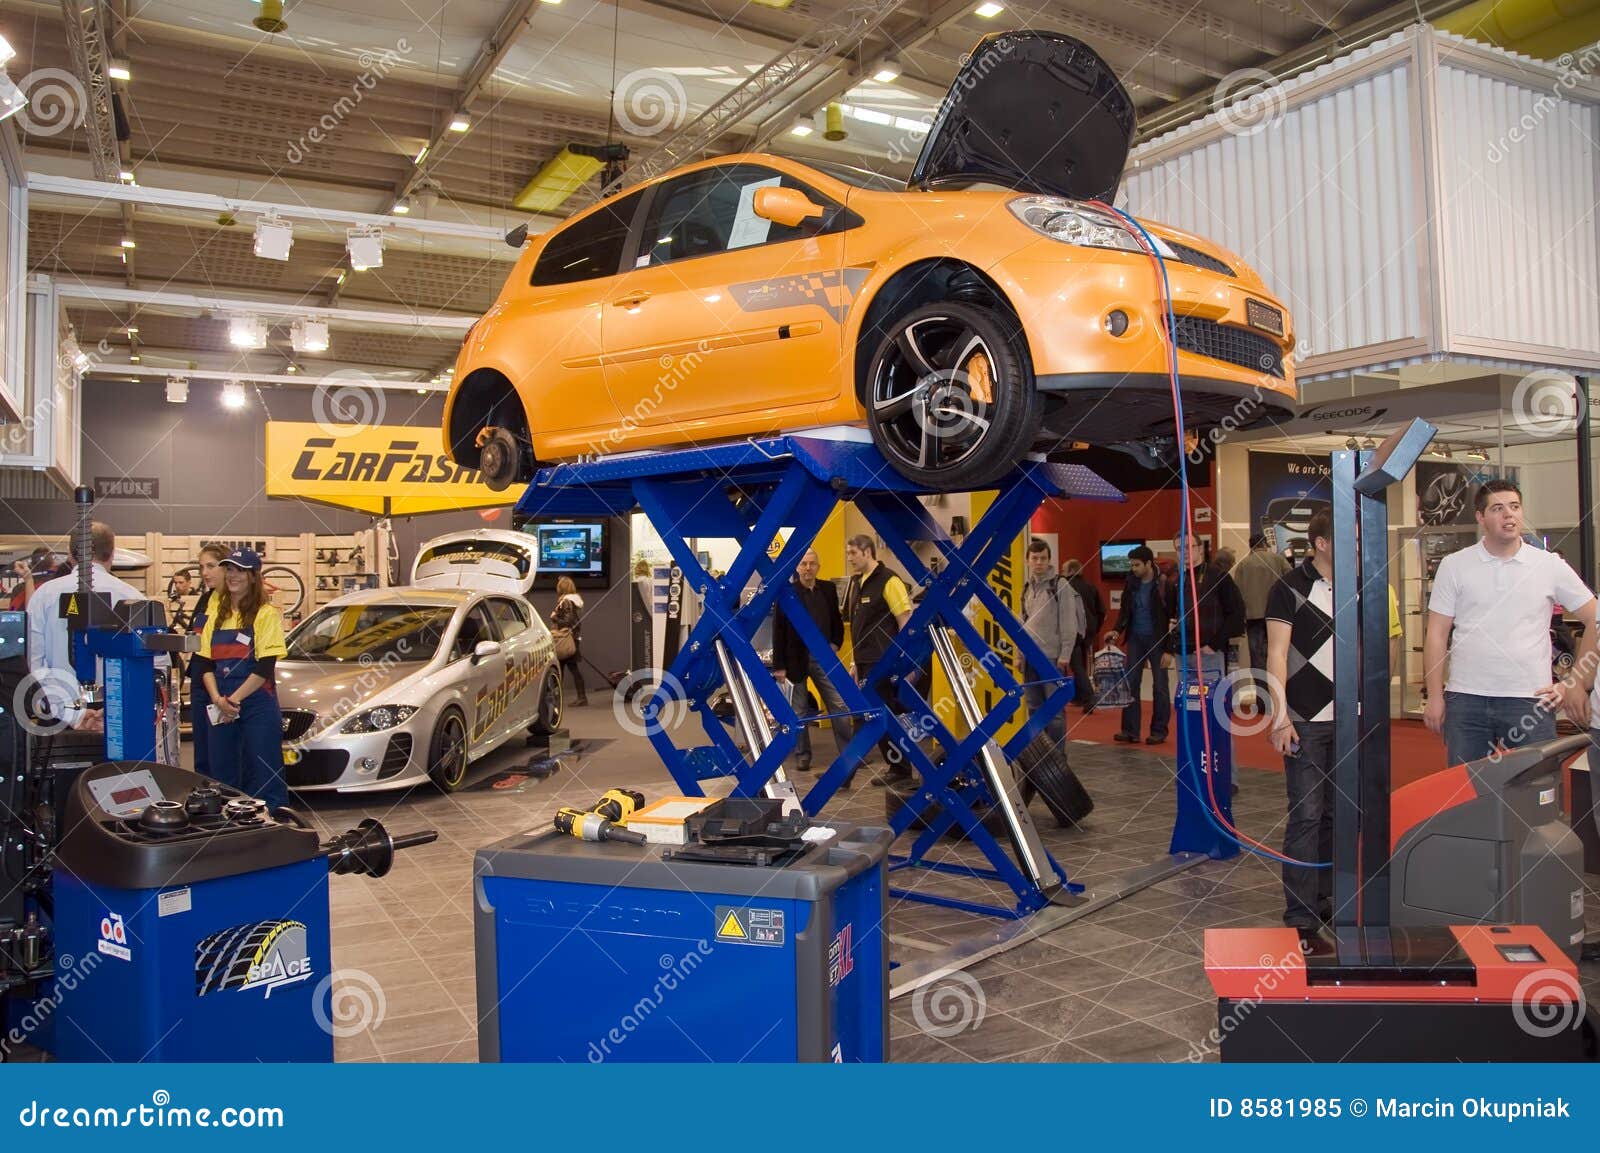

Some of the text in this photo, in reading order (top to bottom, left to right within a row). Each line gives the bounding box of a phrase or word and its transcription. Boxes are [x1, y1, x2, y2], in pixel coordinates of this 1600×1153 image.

[1312, 405, 1372, 421] SEECODE
[1287, 463, 1301, 474] We
[1302, 465, 1316, 475] are
[99, 481, 153, 495] THULE
[248, 948, 312, 982] SPACE
